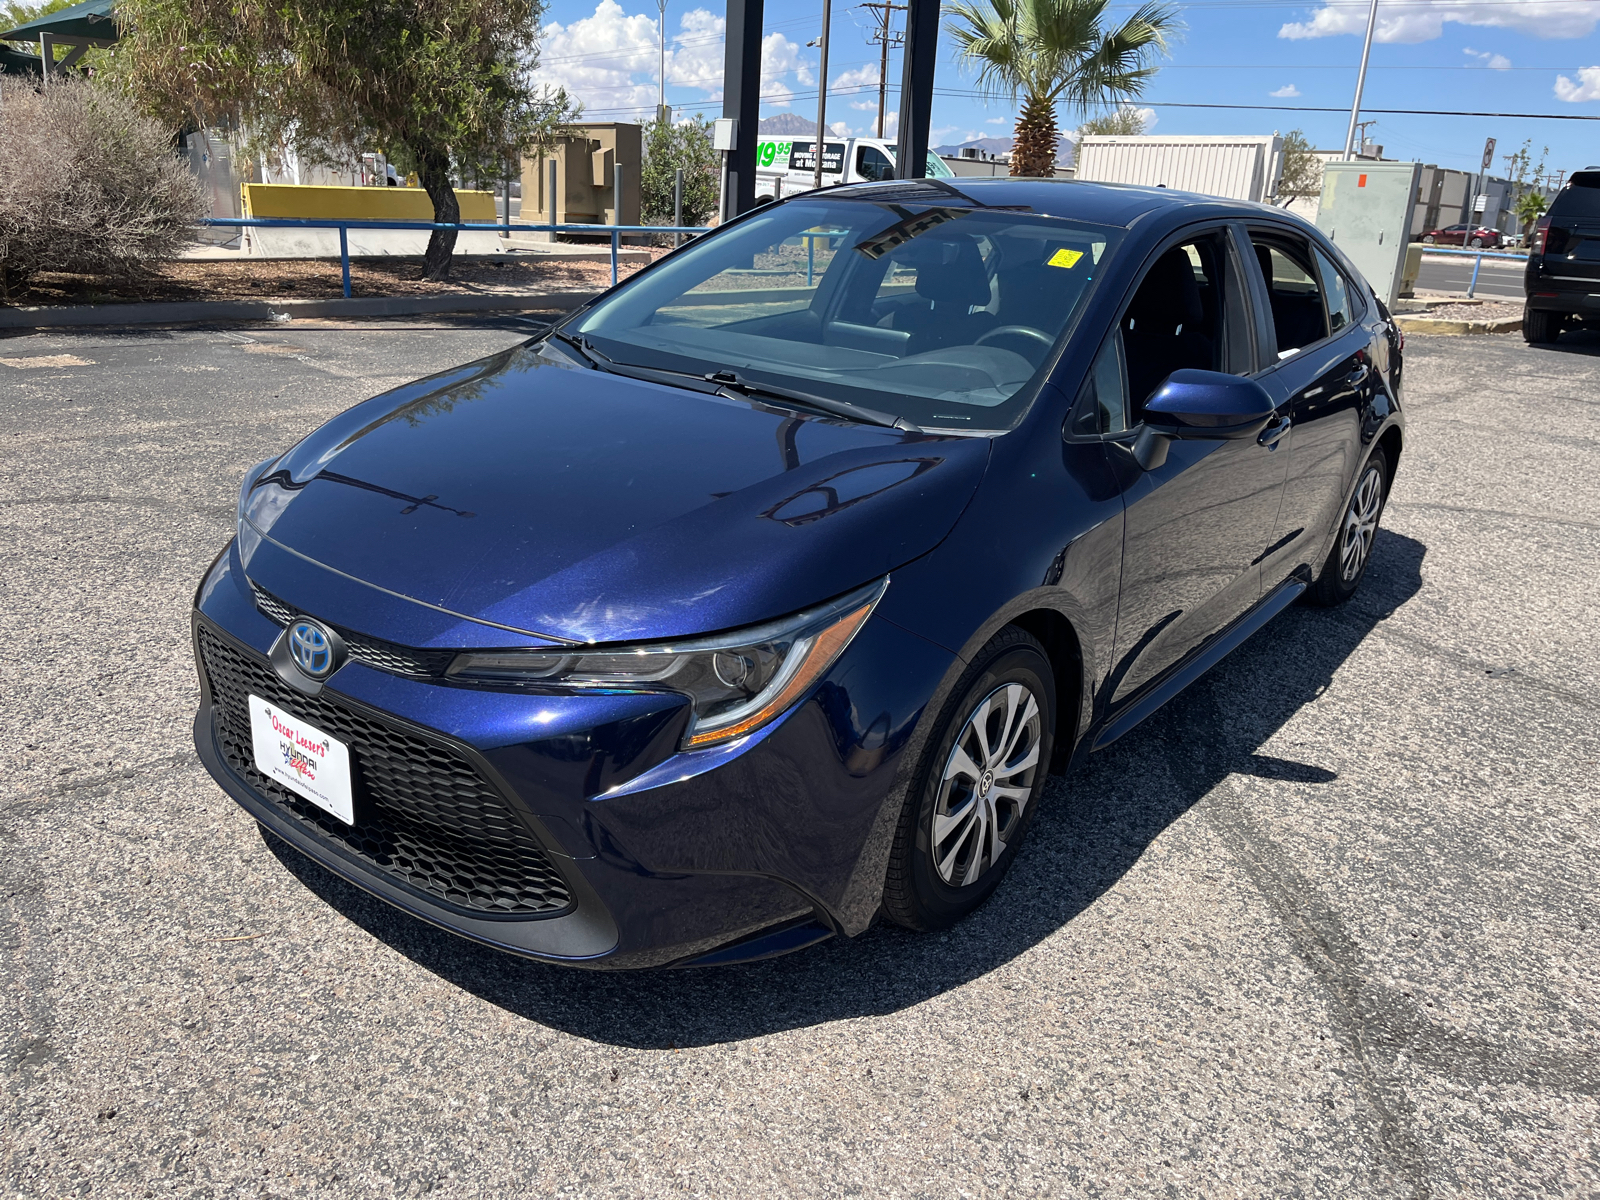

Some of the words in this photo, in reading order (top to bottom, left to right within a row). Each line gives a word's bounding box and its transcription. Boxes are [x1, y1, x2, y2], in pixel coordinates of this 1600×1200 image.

[756, 142, 776, 167] 19
[776, 142, 793, 155] 95
[795, 160, 804, 168] at
[272, 715, 294, 740] Oscar
[296, 730, 325, 758] Leeser's
[279, 740, 318, 771] HYUNDAI
